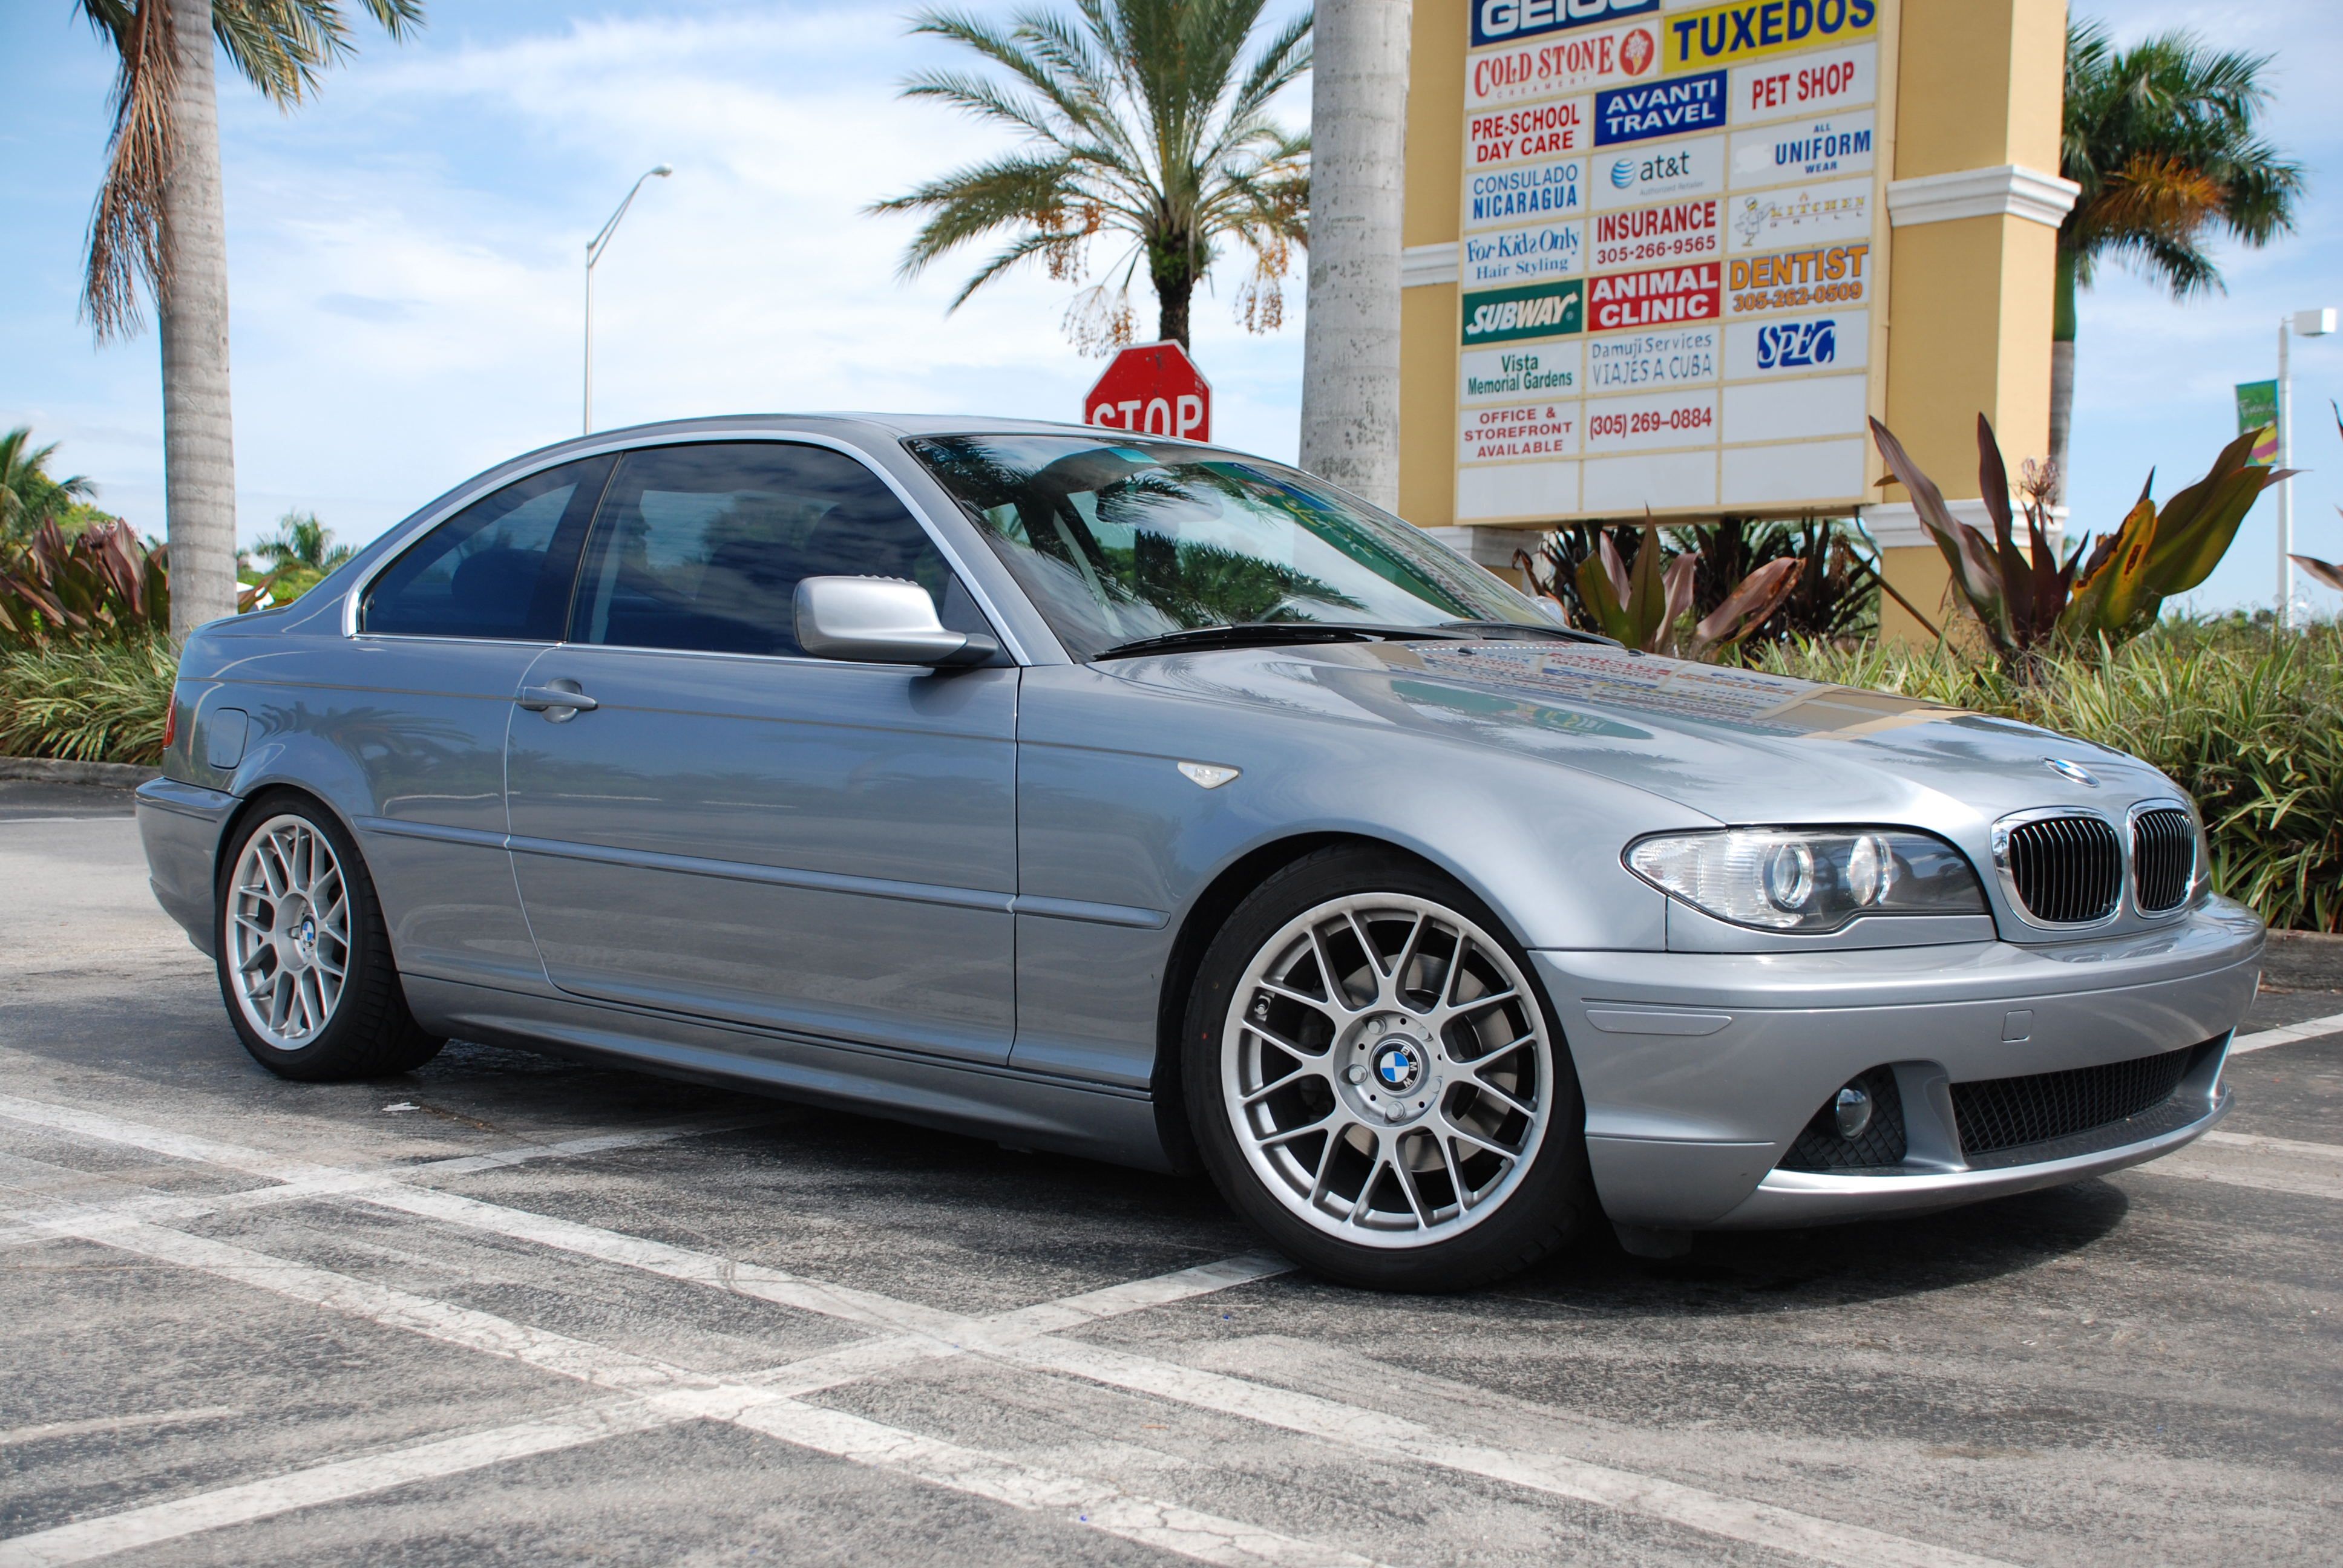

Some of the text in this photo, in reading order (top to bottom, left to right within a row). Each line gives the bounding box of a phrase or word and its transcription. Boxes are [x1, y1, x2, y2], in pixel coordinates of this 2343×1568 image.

[1481, 0, 1649, 37] GEIC
[1673, 0, 1875, 61] TUXEDOS
[1474, 35, 1614, 97] COLD STONE
[1497, 76, 1587, 99] CREAMERY
[1606, 79, 1717, 115] AVANTI
[1752, 61, 1854, 109] PET SHOP
[1472, 104, 1580, 141] PRE-SCHOOL
[1606, 102, 1715, 135] TRAVEL
[1814, 123, 1830, 133] ALL
[1477, 131, 1573, 163] DAY CARE
[1775, 130, 1871, 165] UNIFORM
[1474, 164, 1578, 195] CONSULADO
[1640, 151, 1689, 180] at&t
[1805, 161, 1837, 174] WEAR
[1473, 185, 1577, 219] NICARAGUA
[1771, 195, 1865, 217] KITCHEN
[1598, 200, 1716, 243] INSURANCE
[1467, 227, 1579, 263] For Kids Only
[1598, 235, 1715, 264] 305-266-9565
[1476, 256, 1568, 279] Hair Styling
[1591, 266, 1717, 302] ANIMAL
[1729, 244, 1869, 291] DENTIST
[1599, 294, 1708, 327] CLINIC
[1733, 281, 1862, 312] 305-262-0509
[1466, 292, 1578, 335] SUBWAY
[1592, 333, 1711, 359] Damuji Services
[1757, 319, 1835, 368] SPEC
[1501, 354, 1538, 373] Vista
[1593, 353, 1712, 386] VIAJES A CUBA
[1468, 371, 1572, 395] Memorial Gardens
[1464, 422, 1572, 442] STOREFRONT
[1480, 407, 1555, 424] OFFICE &
[1590, 407, 1712, 440] (305) 269-0884
[1477, 439, 1563, 457] AVAILABLE
[1400, 1045, 1418, 1088] BMW
